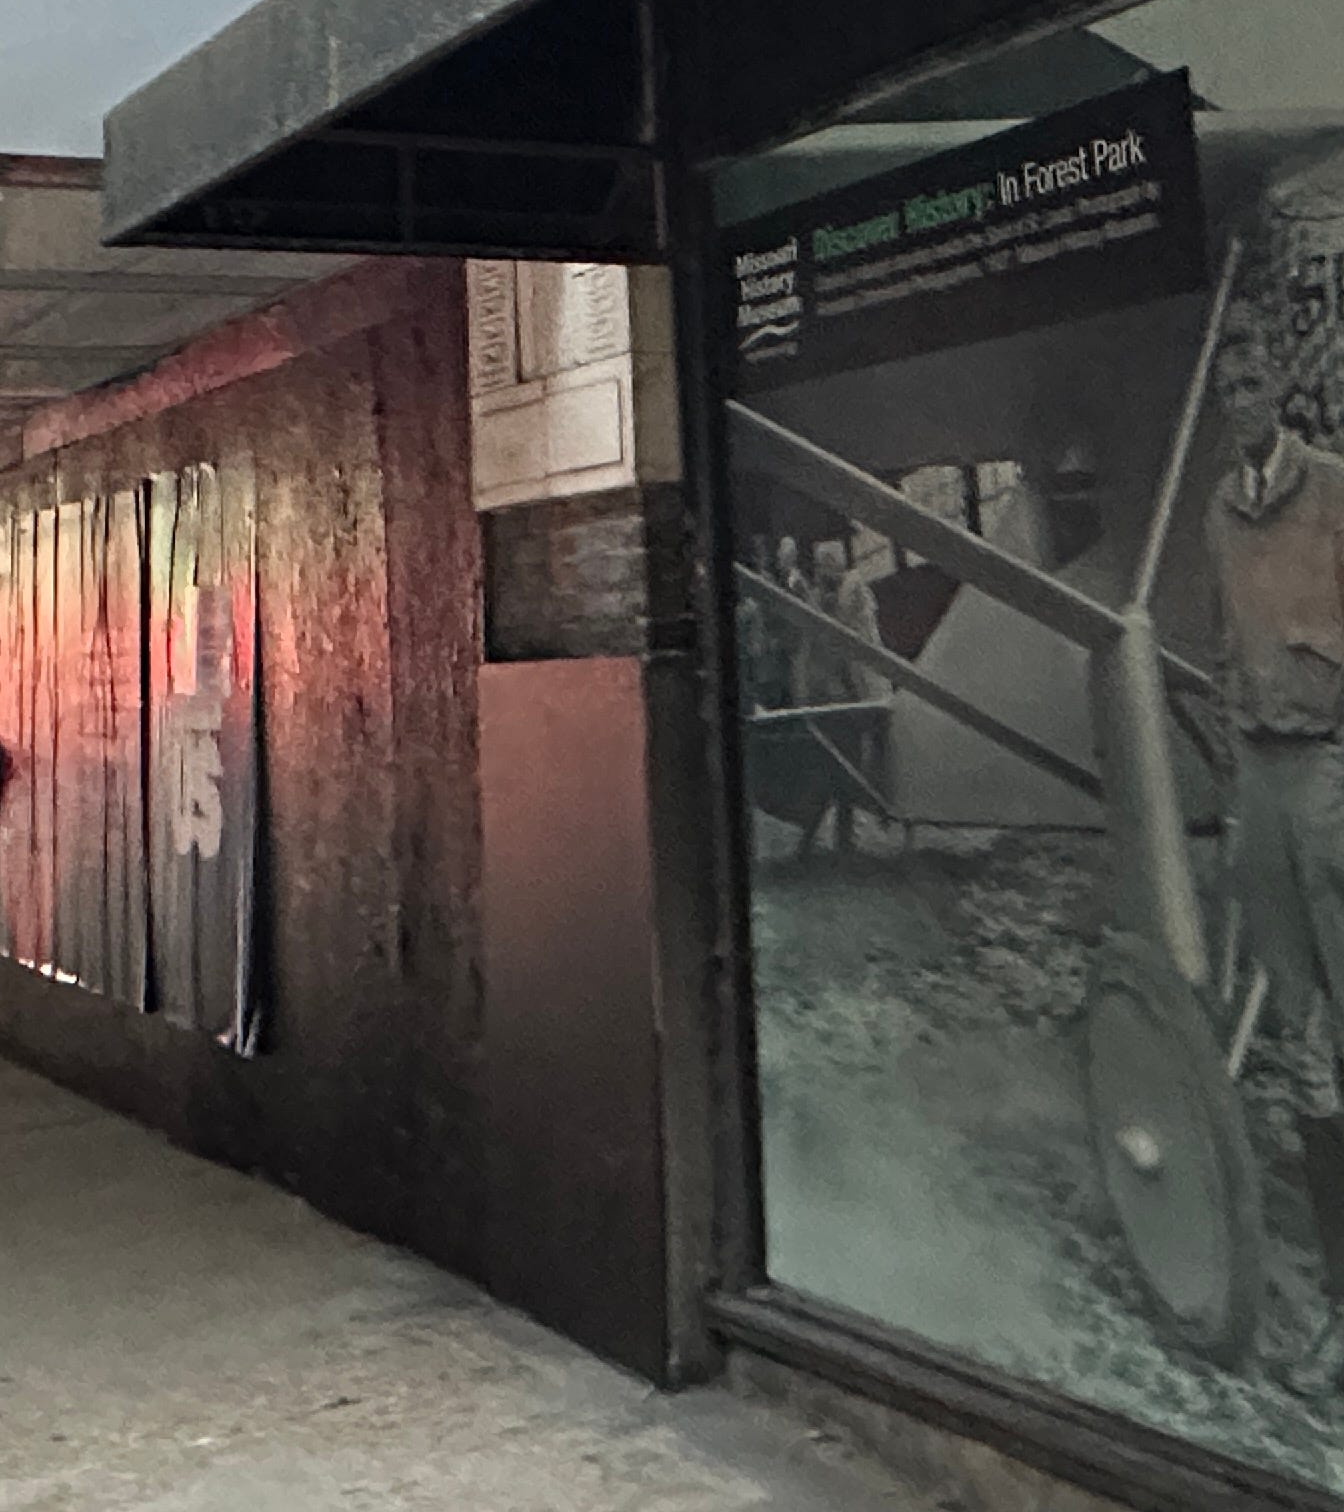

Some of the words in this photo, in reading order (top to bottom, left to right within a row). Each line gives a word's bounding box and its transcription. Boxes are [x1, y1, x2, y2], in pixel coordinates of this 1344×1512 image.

[998, 171, 1018, 205] In
[1024, 146, 1088, 199] Forest
[1094, 129, 1146, 173] Park
